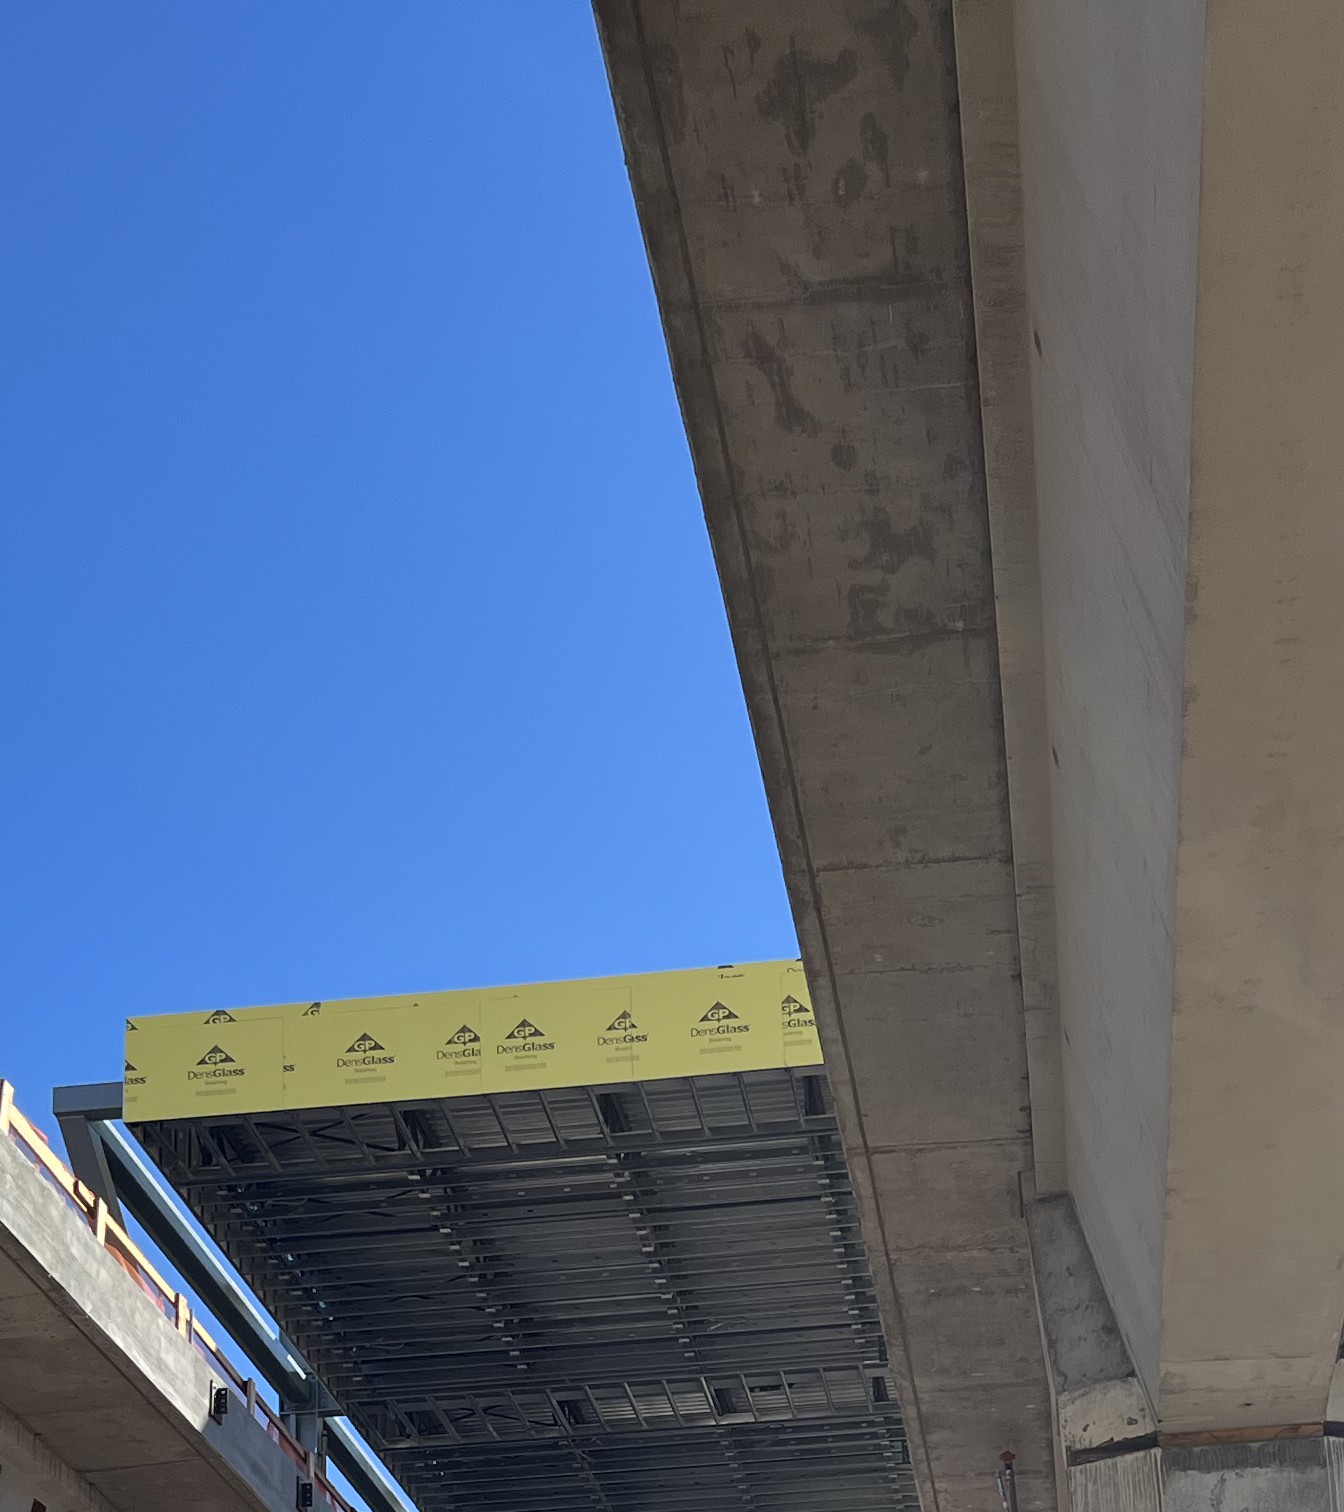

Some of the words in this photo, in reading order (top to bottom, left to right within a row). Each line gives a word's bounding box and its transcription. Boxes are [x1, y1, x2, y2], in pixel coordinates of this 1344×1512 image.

[707, 1008, 730, 1020] GP
[513, 1026, 536, 1037] GP
[690, 1024, 750, 1038] DensGlass
[453, 1032, 475, 1043] GP
[353, 1040, 375, 1051] GP
[496, 1041, 555, 1055] DensGlass
[205, 1052, 227, 1064] GP
[336, 1055, 395, 1068] DensGlass
[187, 1068, 246, 1081] DensGlass
